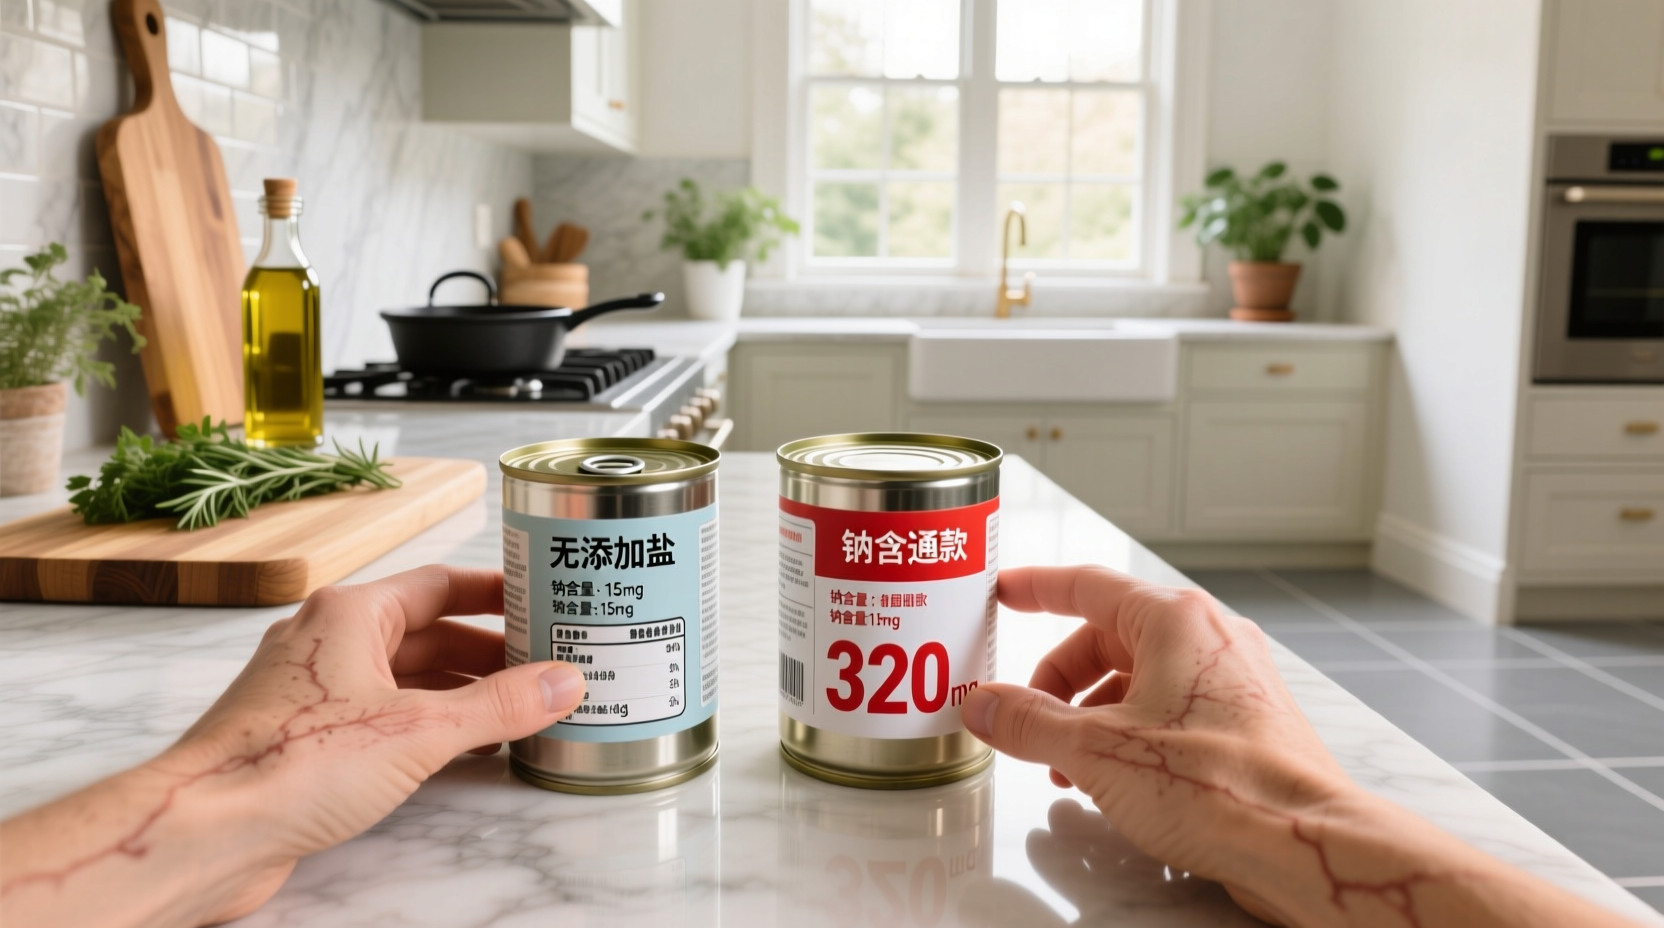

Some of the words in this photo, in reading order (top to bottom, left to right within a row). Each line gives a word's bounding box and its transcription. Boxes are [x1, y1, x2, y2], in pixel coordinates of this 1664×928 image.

[550, 533, 676, 570] 无添加盐
[841, 528, 968, 566] 钠含通款
[604, 581, 644, 601] 15mg
